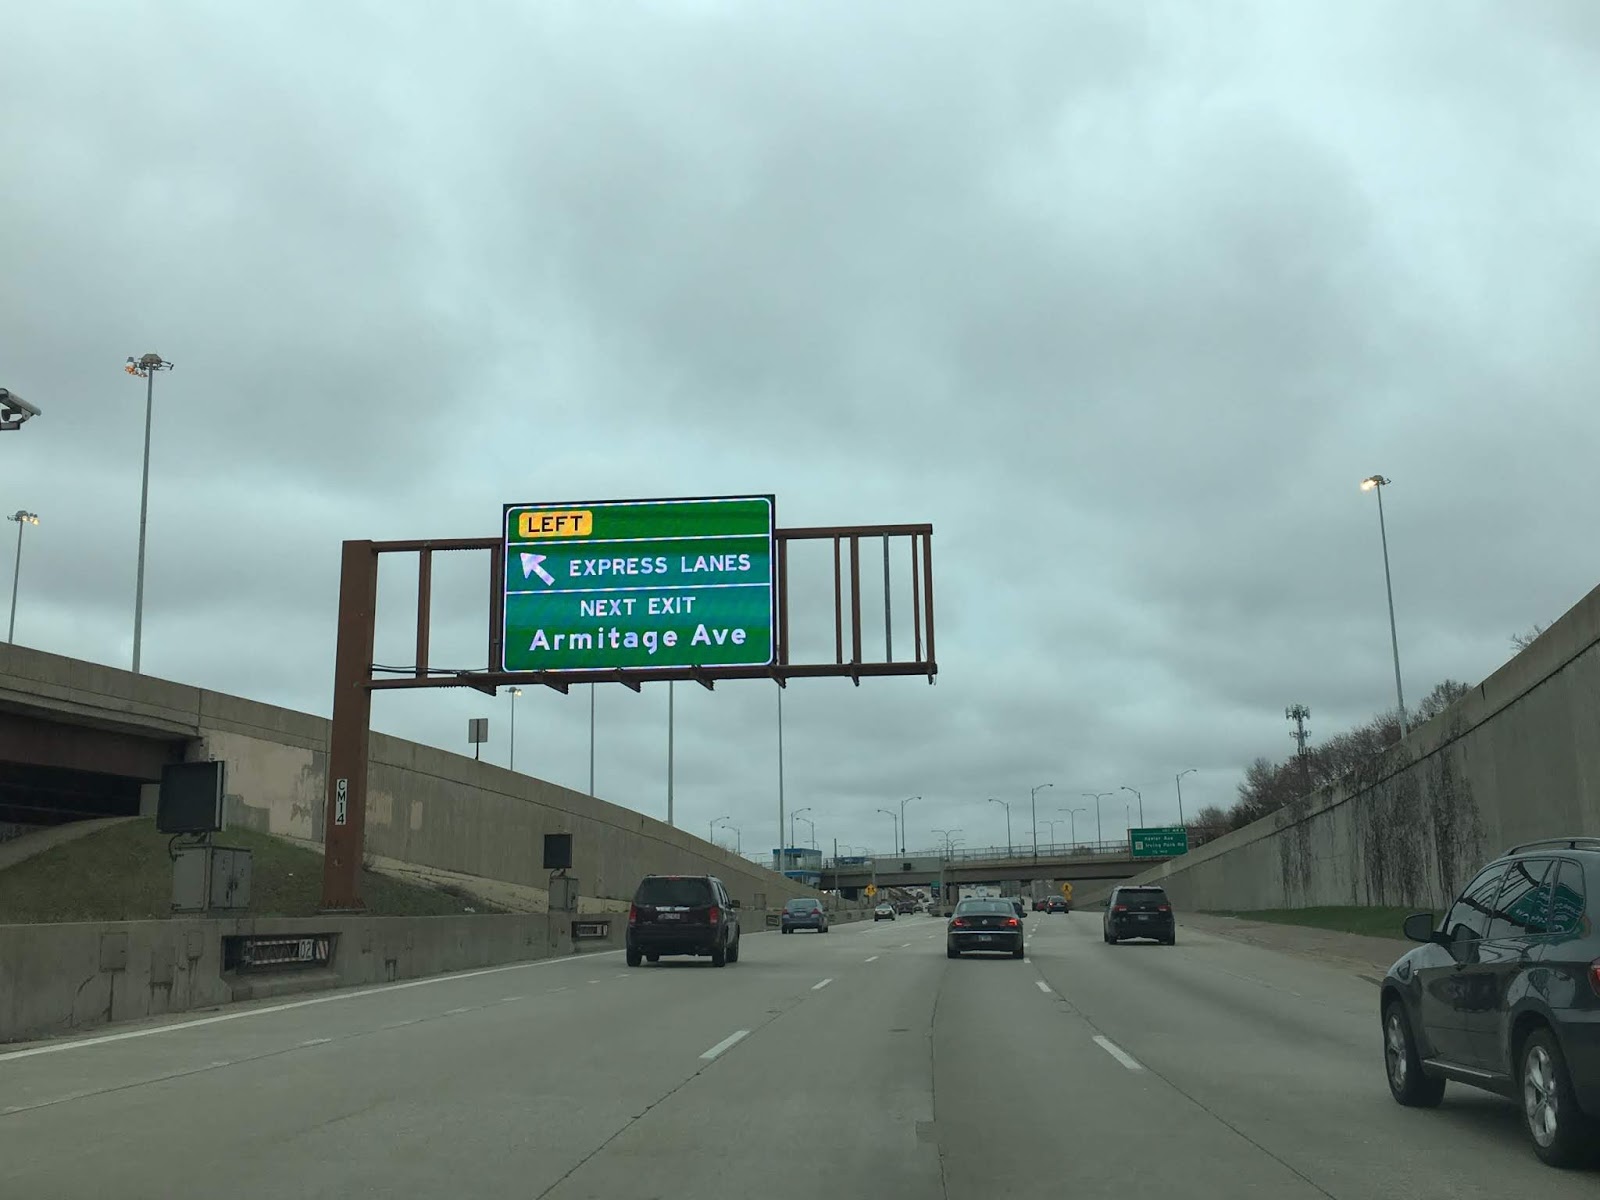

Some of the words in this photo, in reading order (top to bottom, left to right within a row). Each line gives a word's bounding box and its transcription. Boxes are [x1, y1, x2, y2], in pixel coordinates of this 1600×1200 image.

[528, 515, 583, 532] LEFT
[569, 556, 668, 577] EXPRESS
[681, 553, 751, 573] LANES
[580, 598, 637, 617] NEXT
[648, 596, 696, 615] EXIT
[528, 626, 679, 655] Armitage
[690, 623, 747, 647] Ave
[337, 780, 346, 825] CM14
